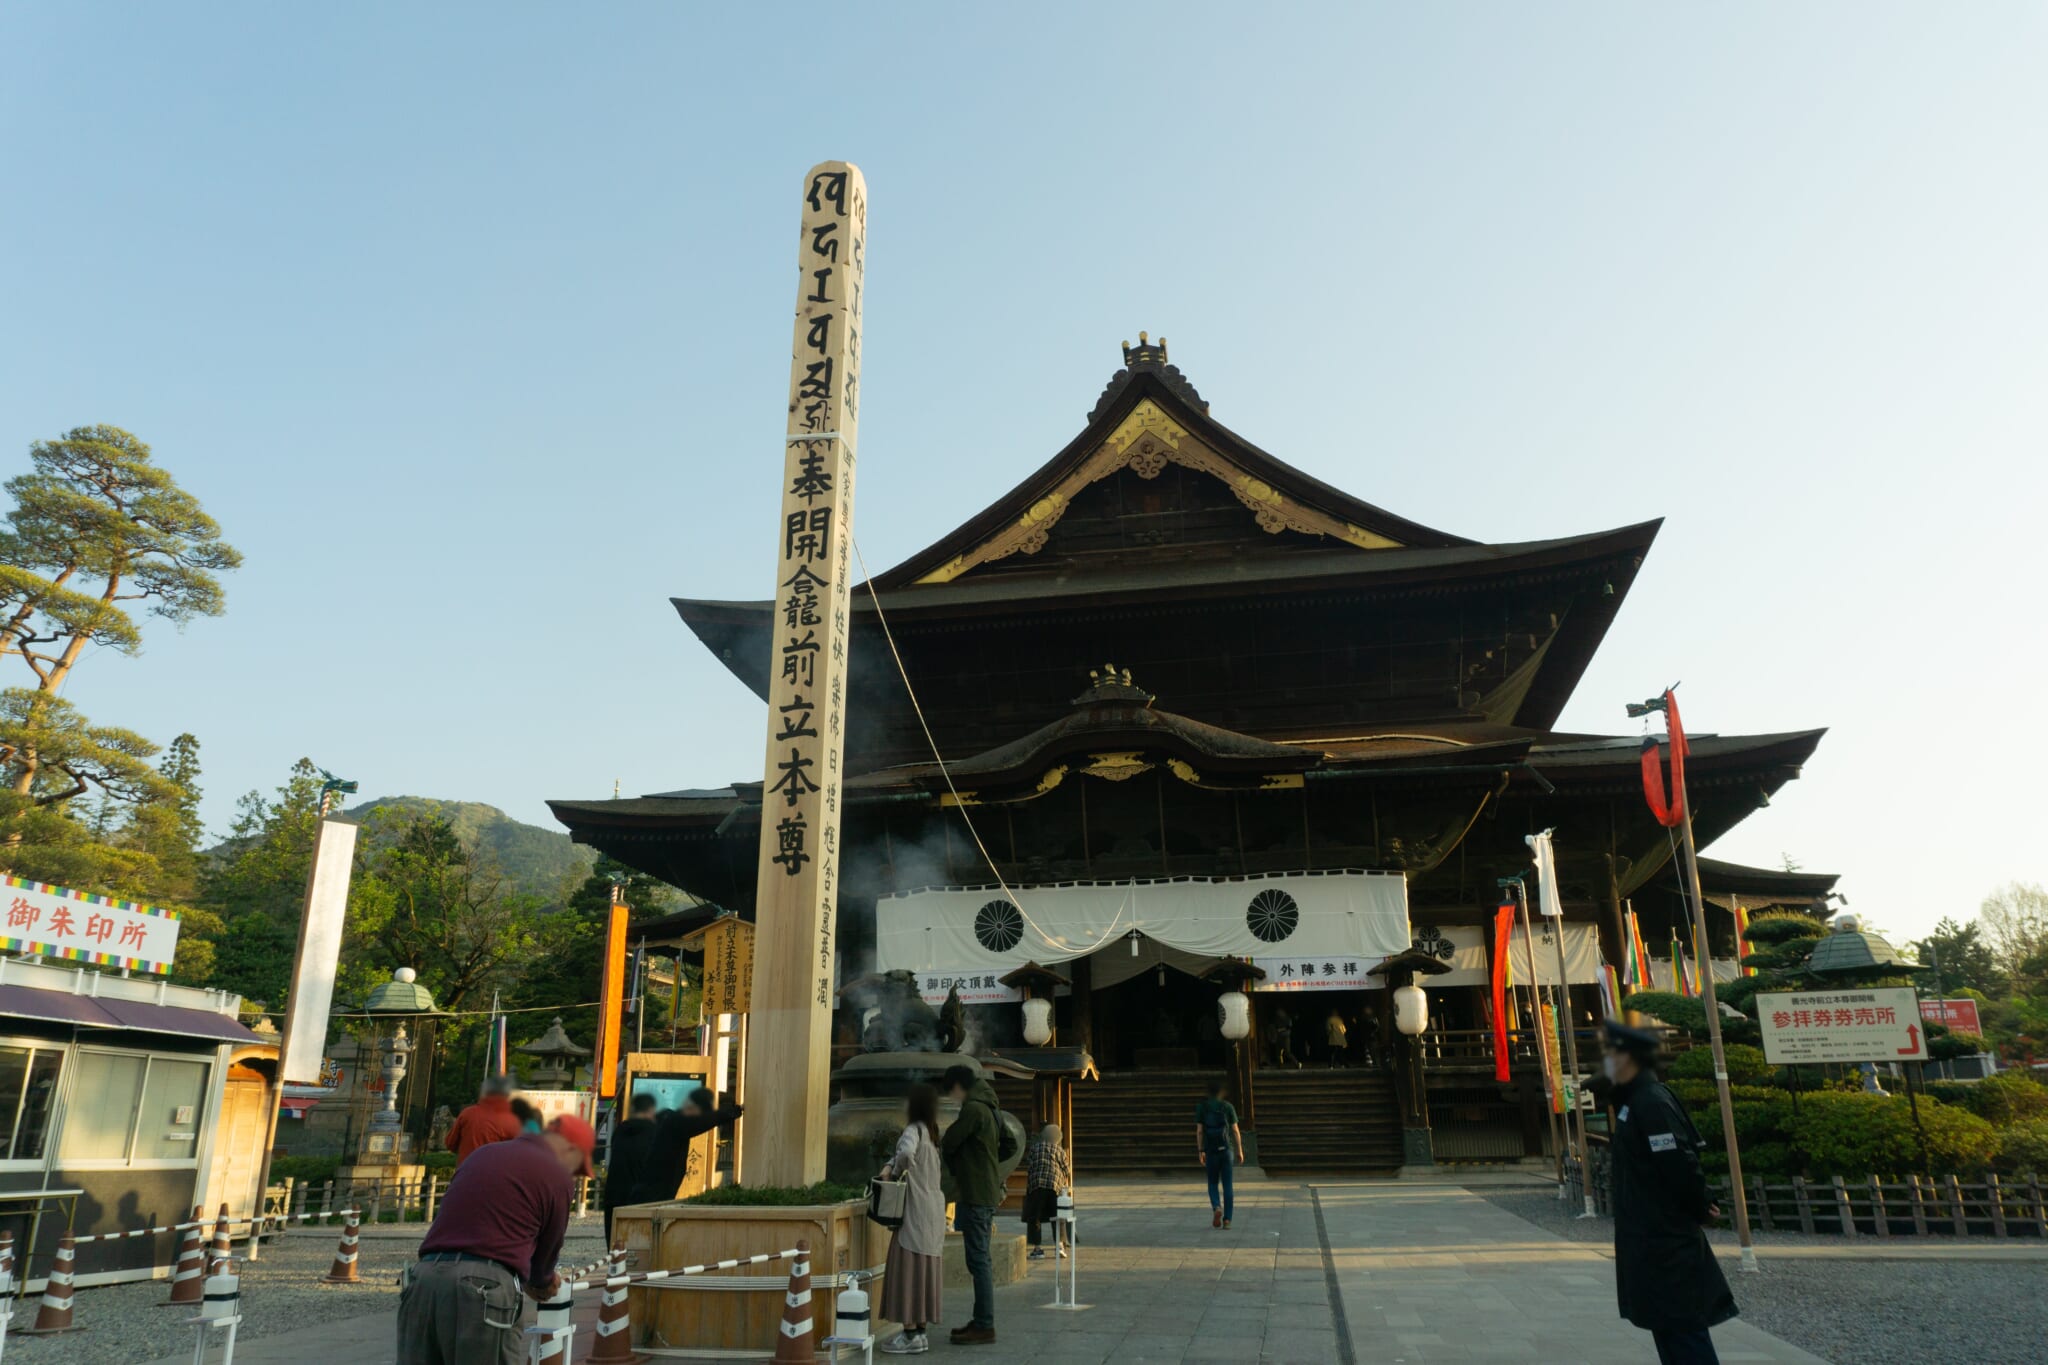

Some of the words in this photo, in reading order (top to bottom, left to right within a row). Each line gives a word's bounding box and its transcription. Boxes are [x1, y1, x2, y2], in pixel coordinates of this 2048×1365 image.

[7, 897, 148, 951] 御朱印所
[926, 975, 996, 991] 御印文頂戴
[1280, 962, 1358, 977] 外陣参拝
[705, 970, 716, 1010] 善光寺
[1772, 1006, 1896, 1029] 参拝券券売所
[686, 1148, 702, 1180] 令和
